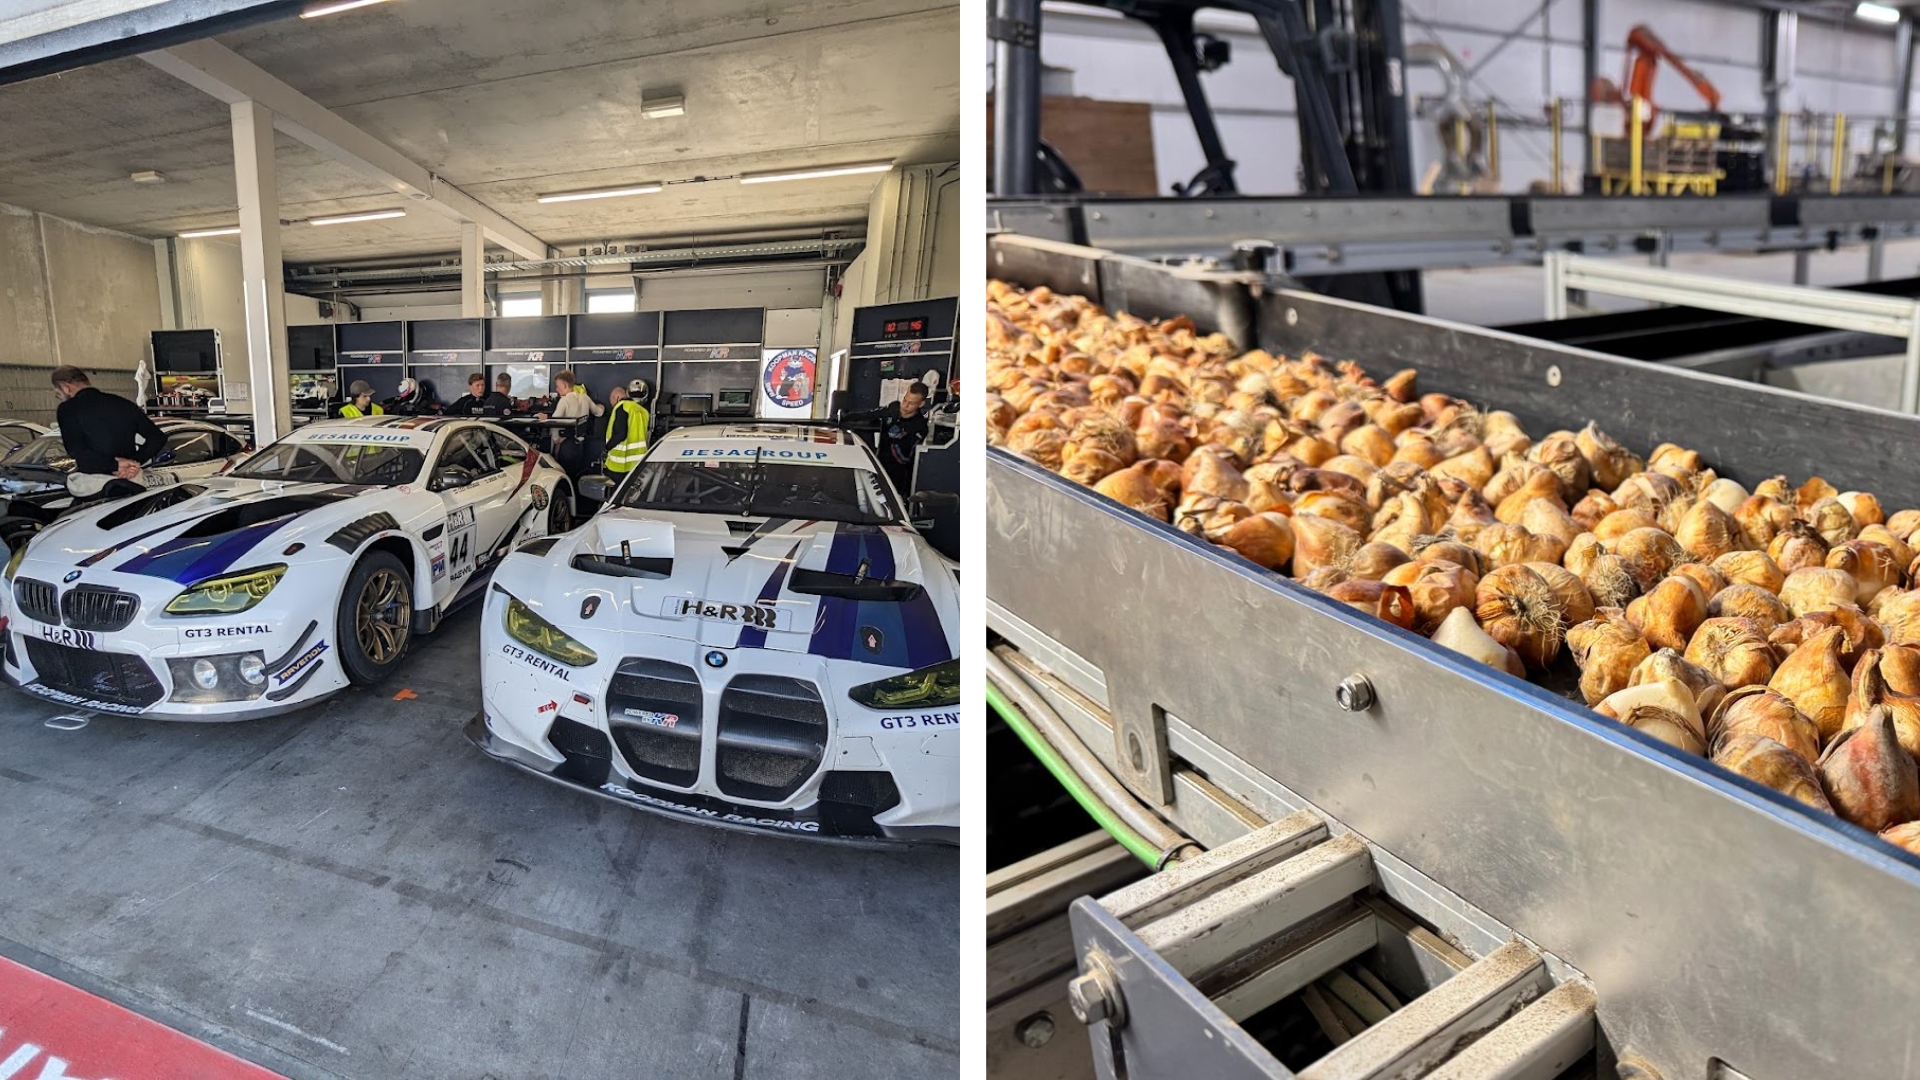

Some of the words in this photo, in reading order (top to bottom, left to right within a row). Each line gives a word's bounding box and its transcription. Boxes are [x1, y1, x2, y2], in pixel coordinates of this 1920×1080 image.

[768, 350, 797, 371] KOOPMAN
[782, 399, 804, 407] SPEED
[307, 433, 410, 442] BESAGROUP
[681, 448, 828, 459] BESAGROUP
[450, 532, 468, 567] 44
[682, 599, 738, 621] H&R
[43, 625, 74, 647] H&R
[185, 628, 212, 638] GT3
[217, 624, 272, 636] RENTAL
[280, 646, 324, 680] RAVENOL
[502, 643, 523, 659] GT3
[524, 654, 570, 682] RENTAL
[651, 712, 679, 728] KR
[880, 716, 917, 729] GT3
[600, 782, 718, 816] KOOPMAN
[723, 813, 820, 832] RACING
